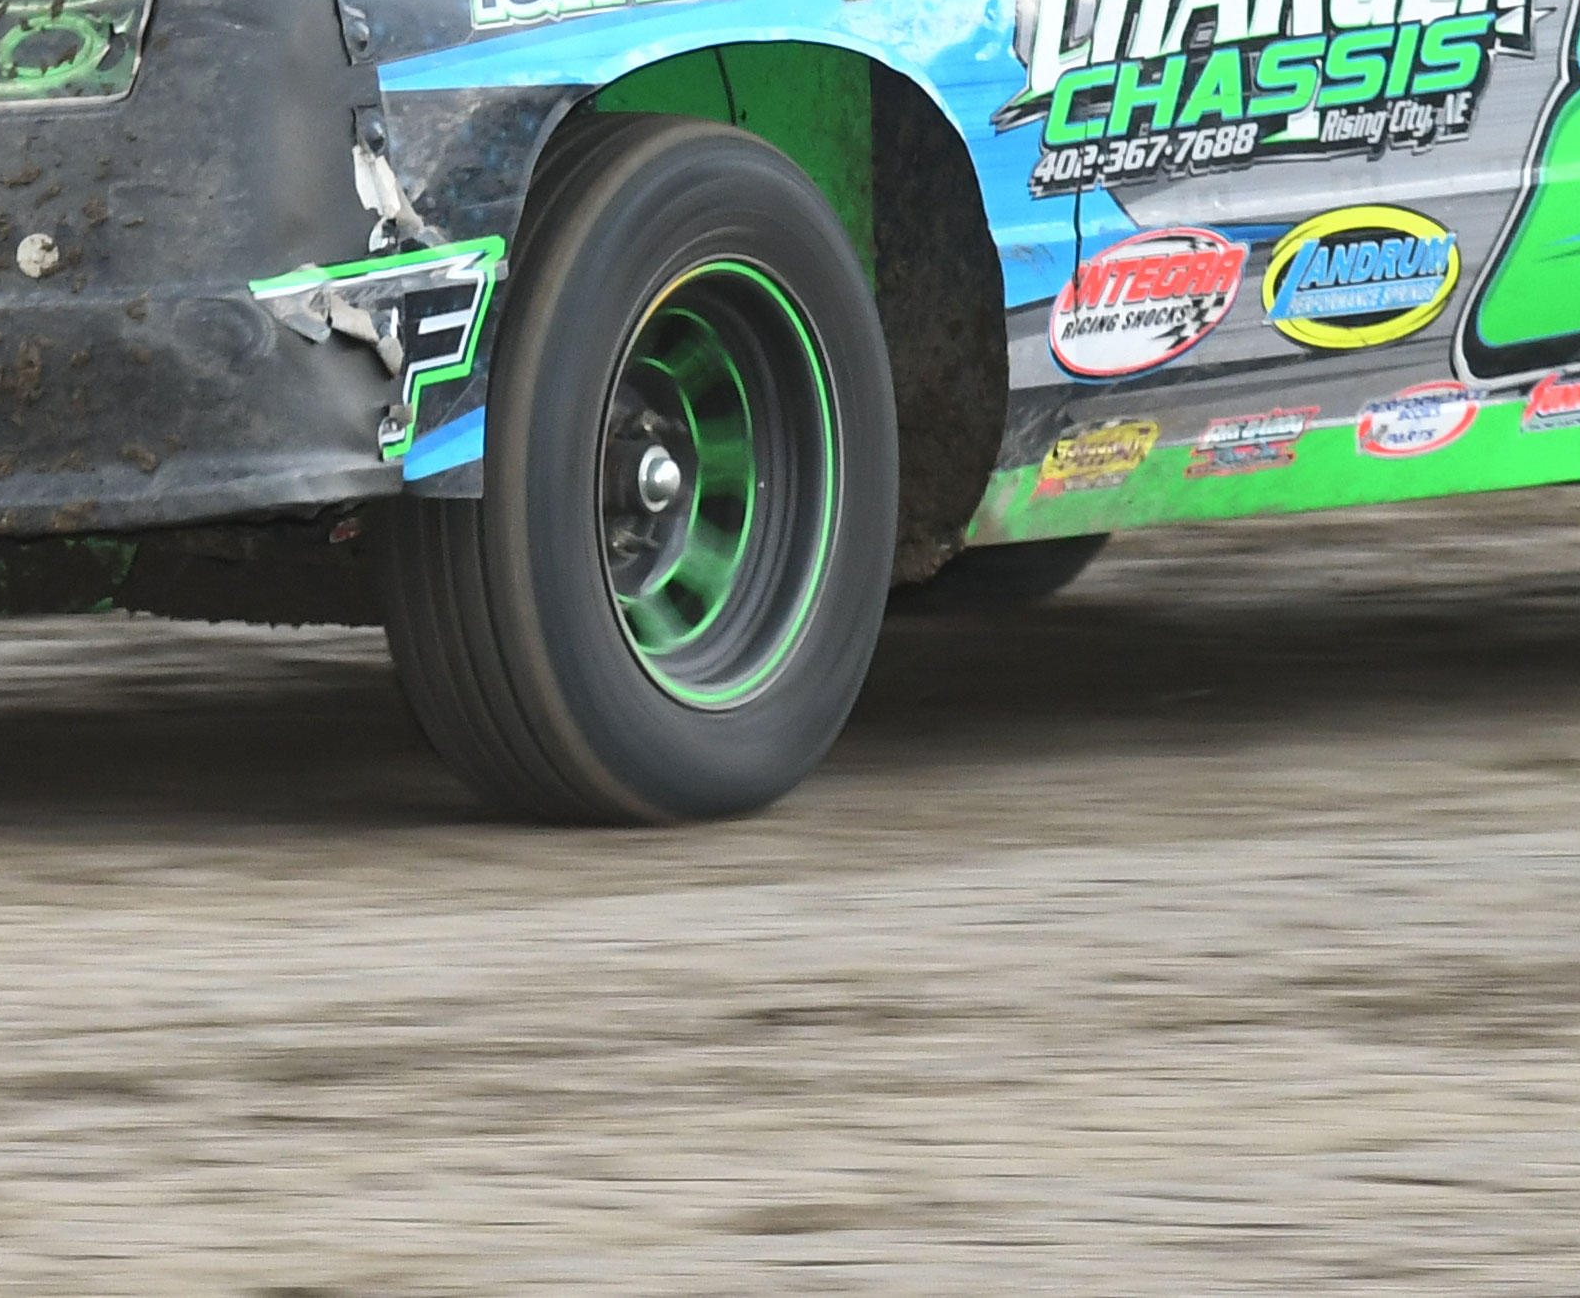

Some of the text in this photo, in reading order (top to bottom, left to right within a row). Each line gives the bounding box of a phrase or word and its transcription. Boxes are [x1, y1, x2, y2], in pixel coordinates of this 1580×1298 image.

[1042, 14, 1497, 145] CHASSIS
[1320, 107, 1388, 144] Rising
[1061, 247, 1246, 316] INTEGRA
[1268, 232, 1456, 320] LANDRUM
